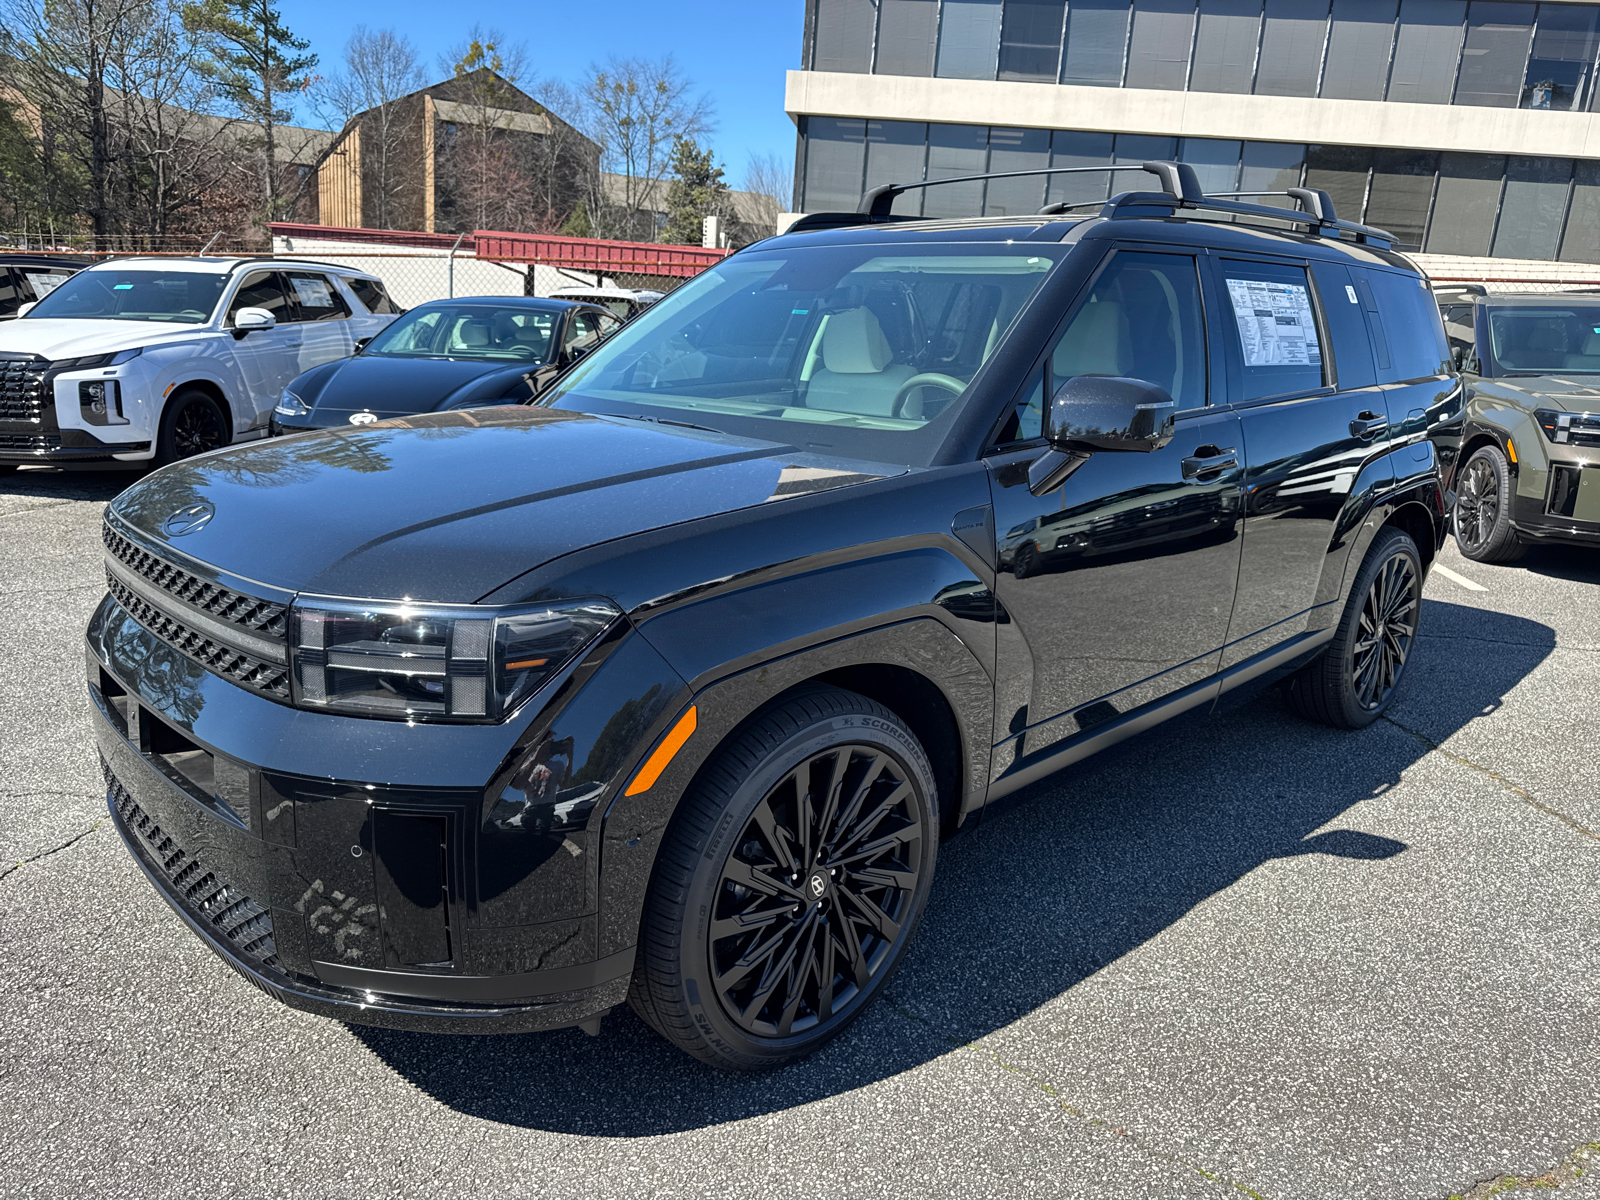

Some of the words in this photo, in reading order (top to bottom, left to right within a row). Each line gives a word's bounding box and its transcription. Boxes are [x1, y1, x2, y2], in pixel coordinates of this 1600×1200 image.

[860, 717, 922, 759] SCORPION
[704, 811, 734, 860] PIRELLI
[694, 1013, 714, 1036] MS
